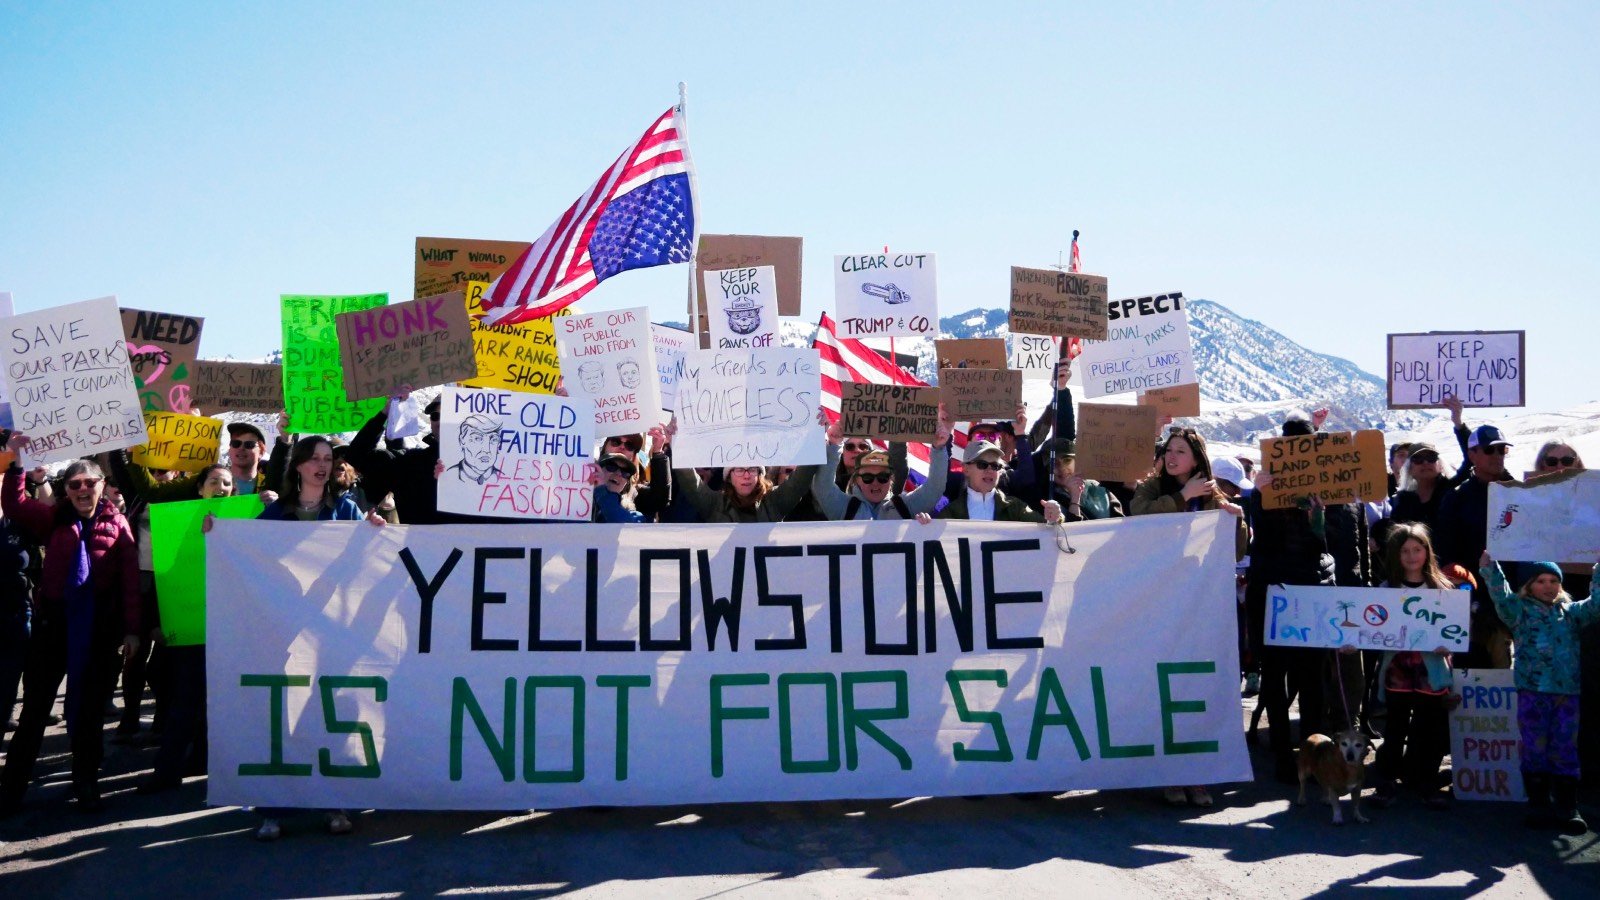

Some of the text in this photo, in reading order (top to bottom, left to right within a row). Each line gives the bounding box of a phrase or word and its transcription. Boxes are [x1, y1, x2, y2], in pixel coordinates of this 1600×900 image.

[420, 248, 506, 264] WHAT WOULD
[841, 254, 927, 273] CLEAR CUT
[720, 268, 758, 285] KEEP
[1015, 270, 1041, 284] WHEN
[1056, 273, 1090, 296] FIRING
[721, 282, 761, 299] YOUR
[1012, 288, 1034, 306] Park
[1108, 292, 1183, 321] SPECT
[132, 311, 201, 345] NEED
[354, 297, 449, 347] HONK
[565, 311, 636, 333] SAVE OUR
[842, 317, 894, 335] TRUMP
[908, 316, 934, 333] CO.
[1013, 318, 1048, 333] TAXING
[1143, 321, 1177, 347] PARKS
[11, 318, 89, 354] SAVE
[287, 325, 307, 344] IS
[583, 328, 621, 342] PUBLIC
[720, 333, 774, 349] PAWS OFF
[356, 331, 450, 363] IF YOU WANT TO
[420, 338, 469, 363] ELON
[474, 338, 559, 368] ARK RANGE
[573, 338, 636, 357] LAND FROM
[1437, 340, 1484, 359] KEEP
[9, 339, 129, 380] OUR PARKS
[128, 351, 172, 373] gers
[1091, 352, 1181, 377] PUBLIC LANDS
[1394, 357, 1518, 382] PUBLIC LANDS
[197, 366, 238, 384] MUSK
[287, 369, 344, 391] FIR
[674, 356, 701, 392] My
[711, 353, 767, 377] friends
[776, 356, 816, 377] are
[945, 371, 1014, 385] BRANCH OUT
[1105, 369, 1181, 394] EMPLOYEES!!
[15, 365, 134, 407] OUR ECONOMY!
[853, 383, 921, 401] SUPPORT
[1004, 386, 1012, 395] 4
[1419, 383, 1493, 406] PUBLIC!
[22, 400, 130, 431] SAVE OUR
[289, 395, 377, 414] PUBLIC
[455, 393, 577, 429] MORE OLD
[594, 408, 641, 424] SPECIES
[680, 386, 812, 428] HOMELESS
[841, 398, 938, 417] FEDERAL EMPLOYEES
[174, 419, 222, 440] BISON
[303, 411, 365, 429] LAND
[24, 428, 73, 455] HEARTS
[89, 414, 144, 446] SOULS!
[498, 430, 589, 458] FAITHFUL
[179, 443, 217, 463] ELON
[710, 441, 780, 467] now
[1271, 438, 1325, 459] STOP
[497, 456, 591, 483] LESS OLD
[1269, 451, 1361, 475] LAND GRABS
[1271, 468, 1362, 491] GREED IS NOT
[478, 484, 592, 518] FASCISTS
[399, 537, 1045, 656] YELLOWSTONE
[1269, 595, 1344, 644] Parks
[1358, 625, 1408, 649] need
[1462, 685, 1517, 711] PROT
[238, 661, 1219, 783] IS NOT FOR SALE
[1456, 767, 1511, 797] OUR
